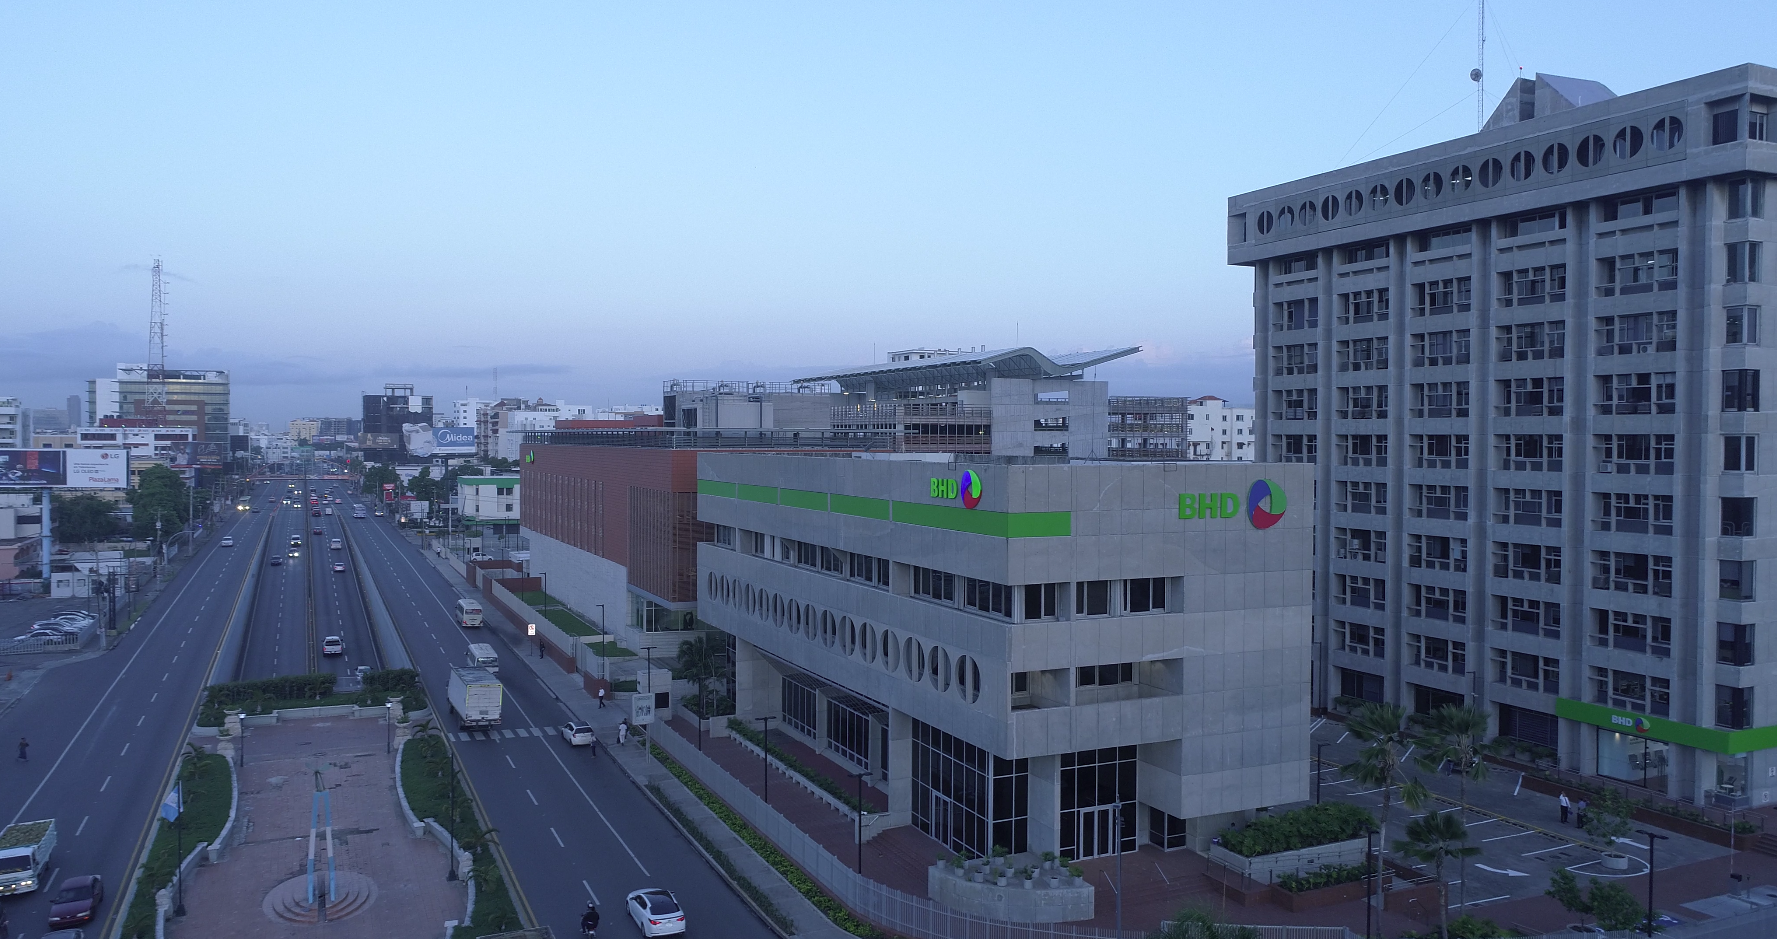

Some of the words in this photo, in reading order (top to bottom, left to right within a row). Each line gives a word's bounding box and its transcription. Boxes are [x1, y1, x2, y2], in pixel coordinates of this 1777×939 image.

[440, 432, 473, 442] Midea
[930, 477, 958, 499] BHD
[1178, 492, 1240, 519] BHD
[1611, 715, 1633, 727] BHD
